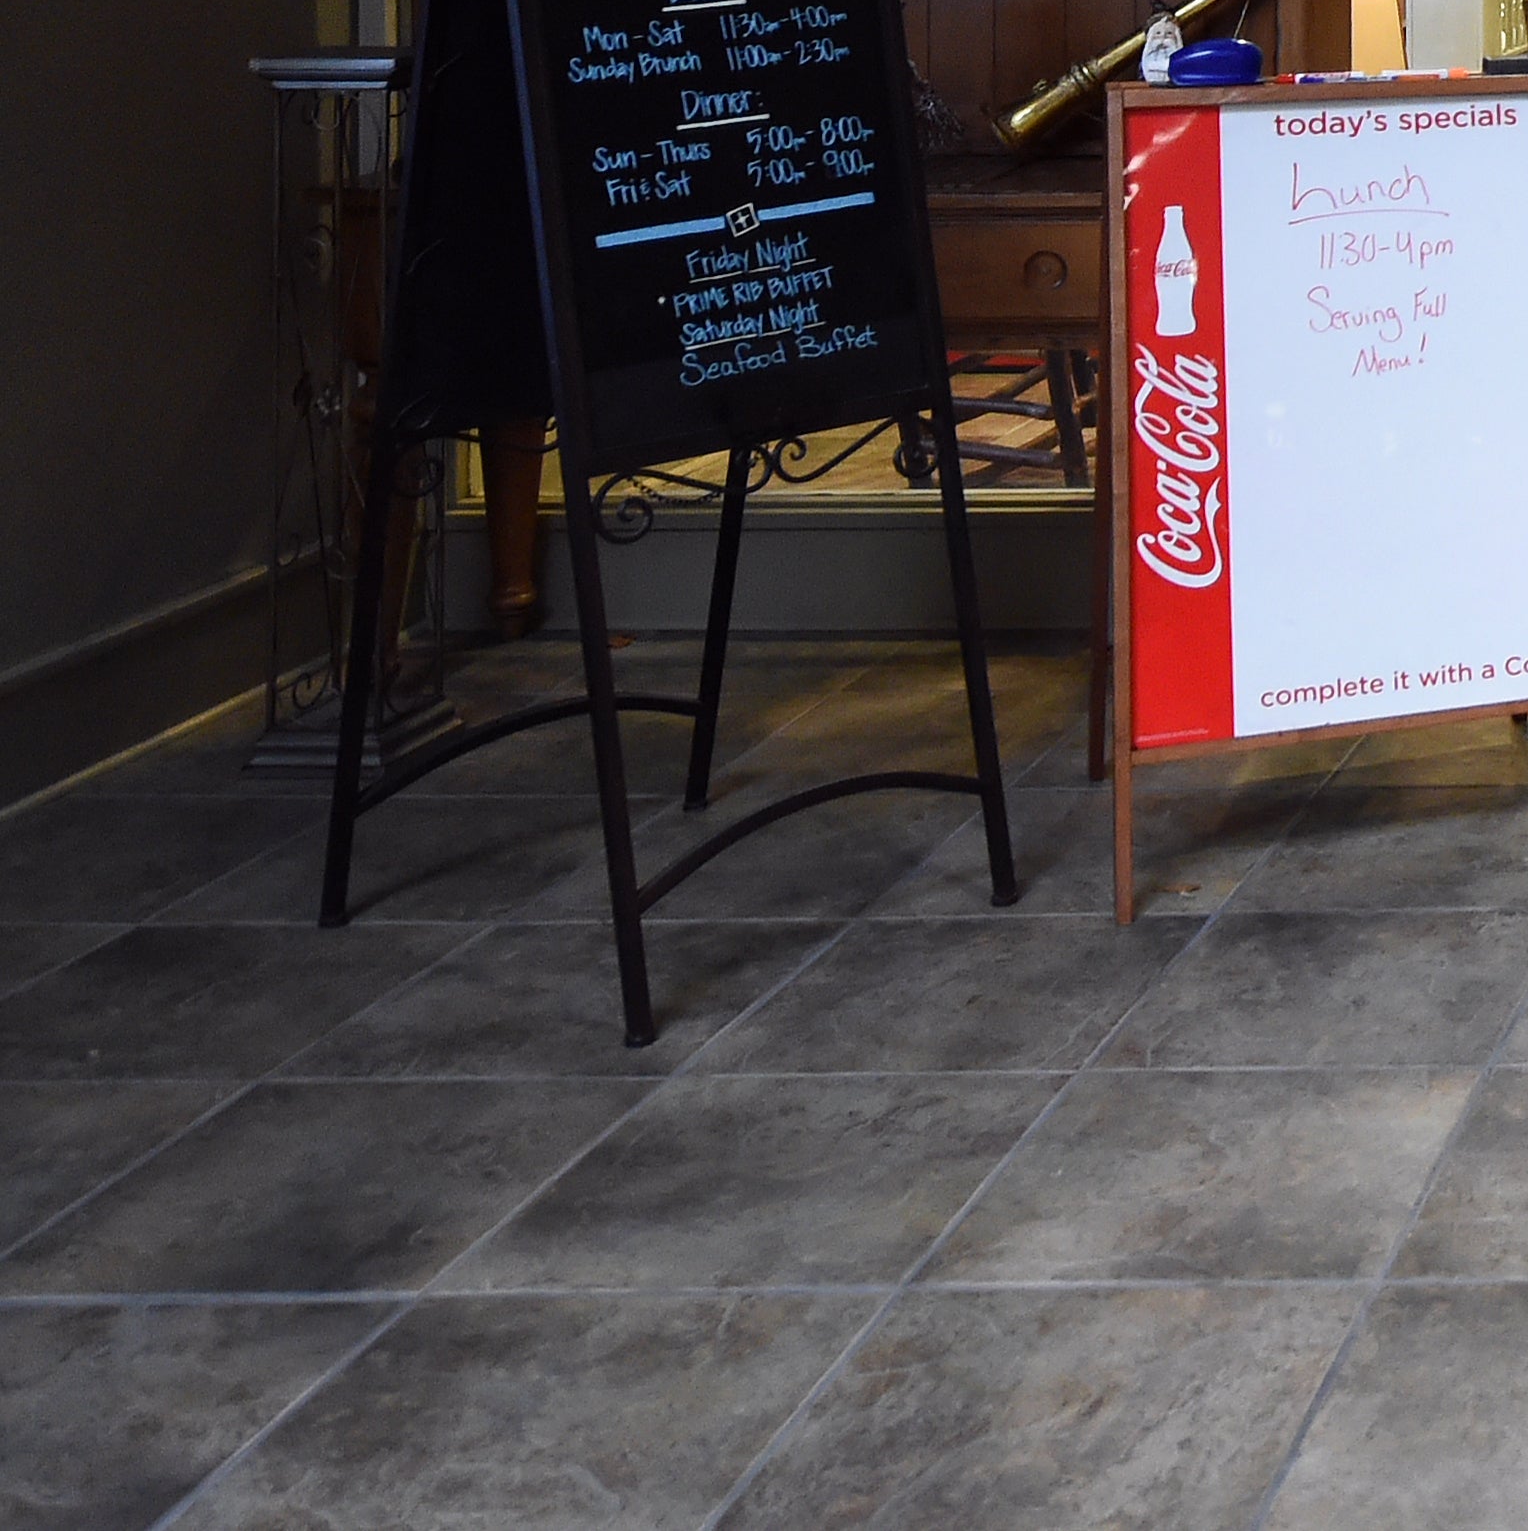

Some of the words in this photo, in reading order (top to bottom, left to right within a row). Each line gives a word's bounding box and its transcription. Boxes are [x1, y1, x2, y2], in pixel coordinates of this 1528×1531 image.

[583, 26, 628, 53] Mon
[647, 20, 685, 47] Sat
[567, 57, 635, 84] Sunday
[638, 50, 703, 77] Brunch
[1275, 111, 1388, 137] today's
[1398, 104, 1518, 134] specials
[592, 146, 638, 172] Sun
[656, 139, 711, 166] Thurs
[606, 178, 638, 207] Fri
[655, 170, 692, 199] Sat
[1291, 161, 1430, 211] Lunch
[685, 244, 749, 279] Friday
[755, 231, 809, 272] Night
[672, 286, 731, 318] PRIME
[731, 280, 764, 306] RIB
[767, 265, 835, 300] BUFFET
[1307, 286, 1404, 343] Serving
[1412, 286, 1448, 322] Full
[679, 313, 764, 346] Saturday
[768, 297, 820, 334] Night
[680, 340, 787, 387] Seafood
[795, 325, 879, 359] Buffet
[1135, 343, 1222, 587] Coca-Cola
[1260, 676, 1385, 708] complete
[1392, 670, 1410, 691] it
[1418, 662, 1473, 688] with
[1481, 663, 1496, 679] a
